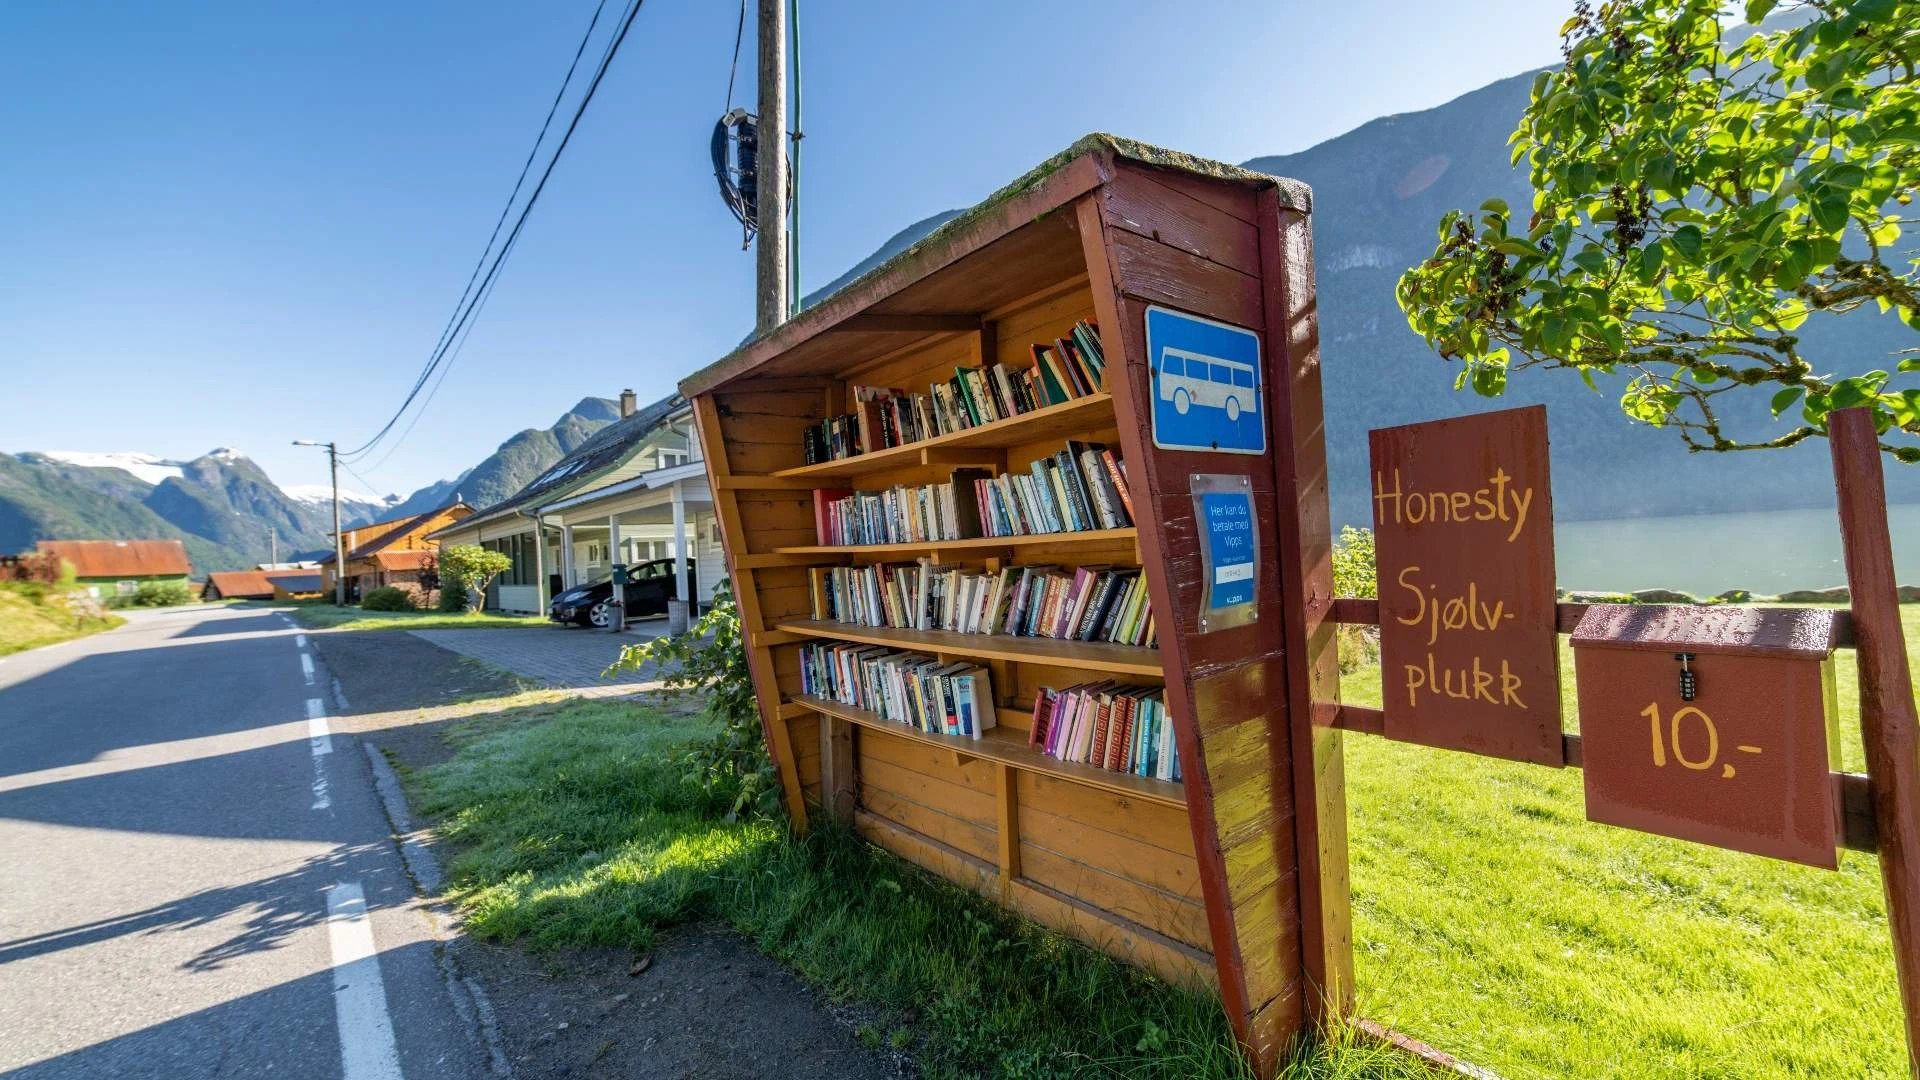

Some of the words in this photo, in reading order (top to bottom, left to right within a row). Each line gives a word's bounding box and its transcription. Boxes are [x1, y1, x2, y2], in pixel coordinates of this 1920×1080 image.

[1210, 505, 1223, 516] Her
[1225, 504, 1236, 515] kan
[1238, 504, 1246, 515] du
[1213, 520, 1234, 531] betale
[1235, 520, 1249, 530] med
[1374, 467, 1533, 543] Honesty
[1224, 535, 1242, 548] Vipps
[1398, 566, 1515, 645] Sjølv-
[1404, 653, 1528, 709] plukk
[1640, 702, 1763, 779] 10,-
